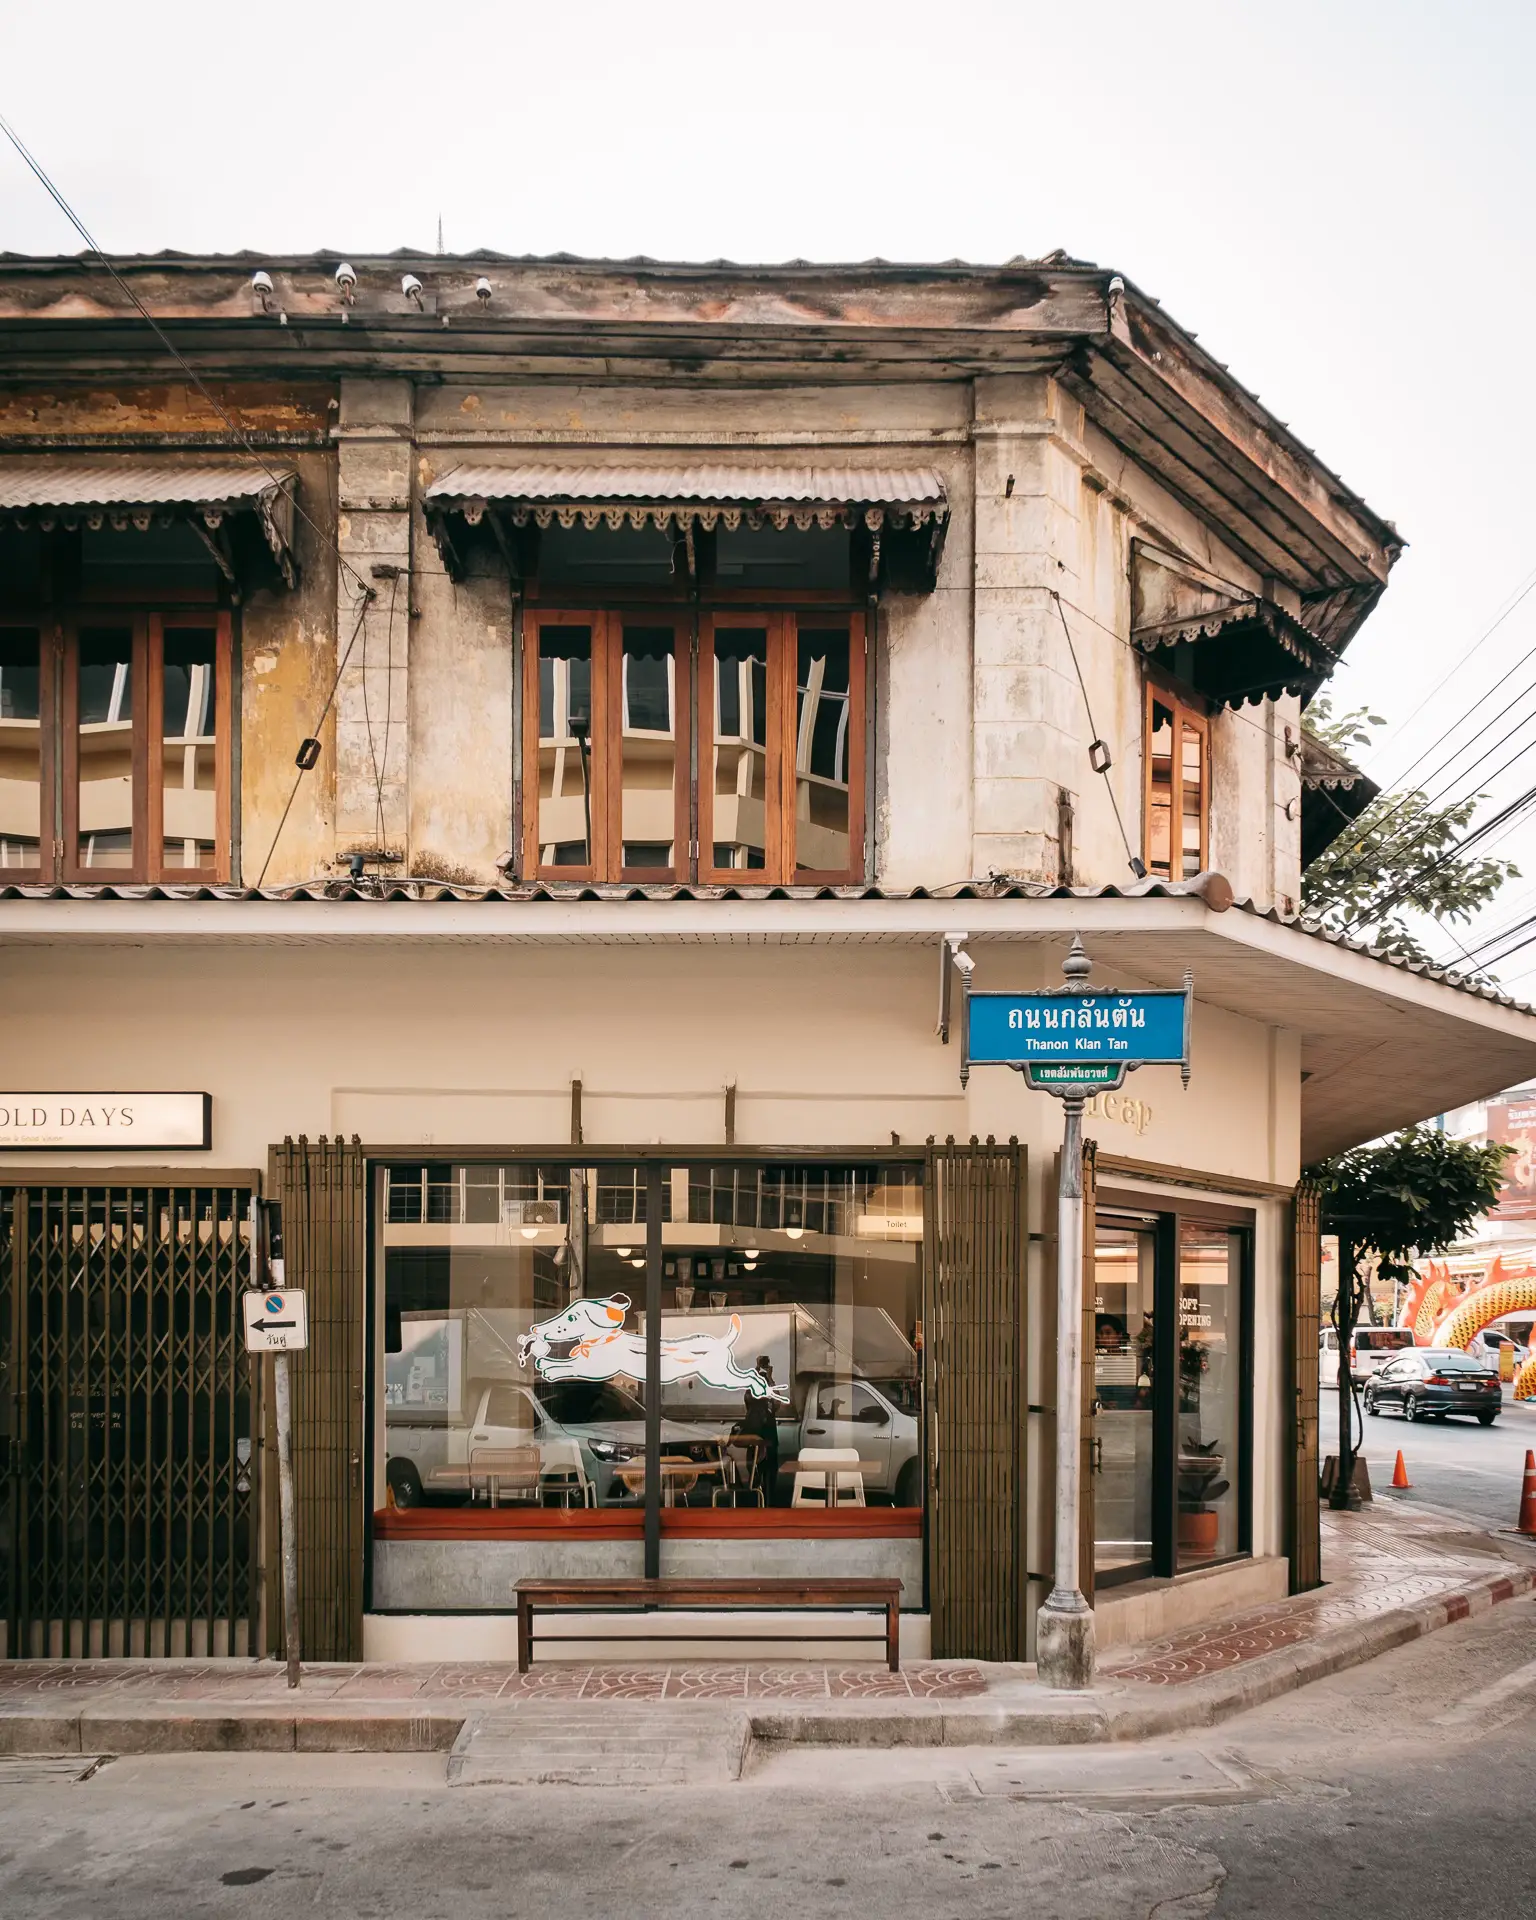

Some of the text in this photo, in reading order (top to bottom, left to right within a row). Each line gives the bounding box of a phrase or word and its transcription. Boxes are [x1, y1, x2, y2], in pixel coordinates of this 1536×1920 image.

[1008, 998, 1146, 1029] ถนนกลันตัน
[1025, 1037, 1128, 1050] Thanon Klan Tan
[1040, 1065, 1109, 1079] เขตสัมพันธวงศ์
[60, 1107, 134, 1127] DAYS
[886, 1220, 907, 1228] Toilet
[1179, 1297, 1198, 1310] SOFT
